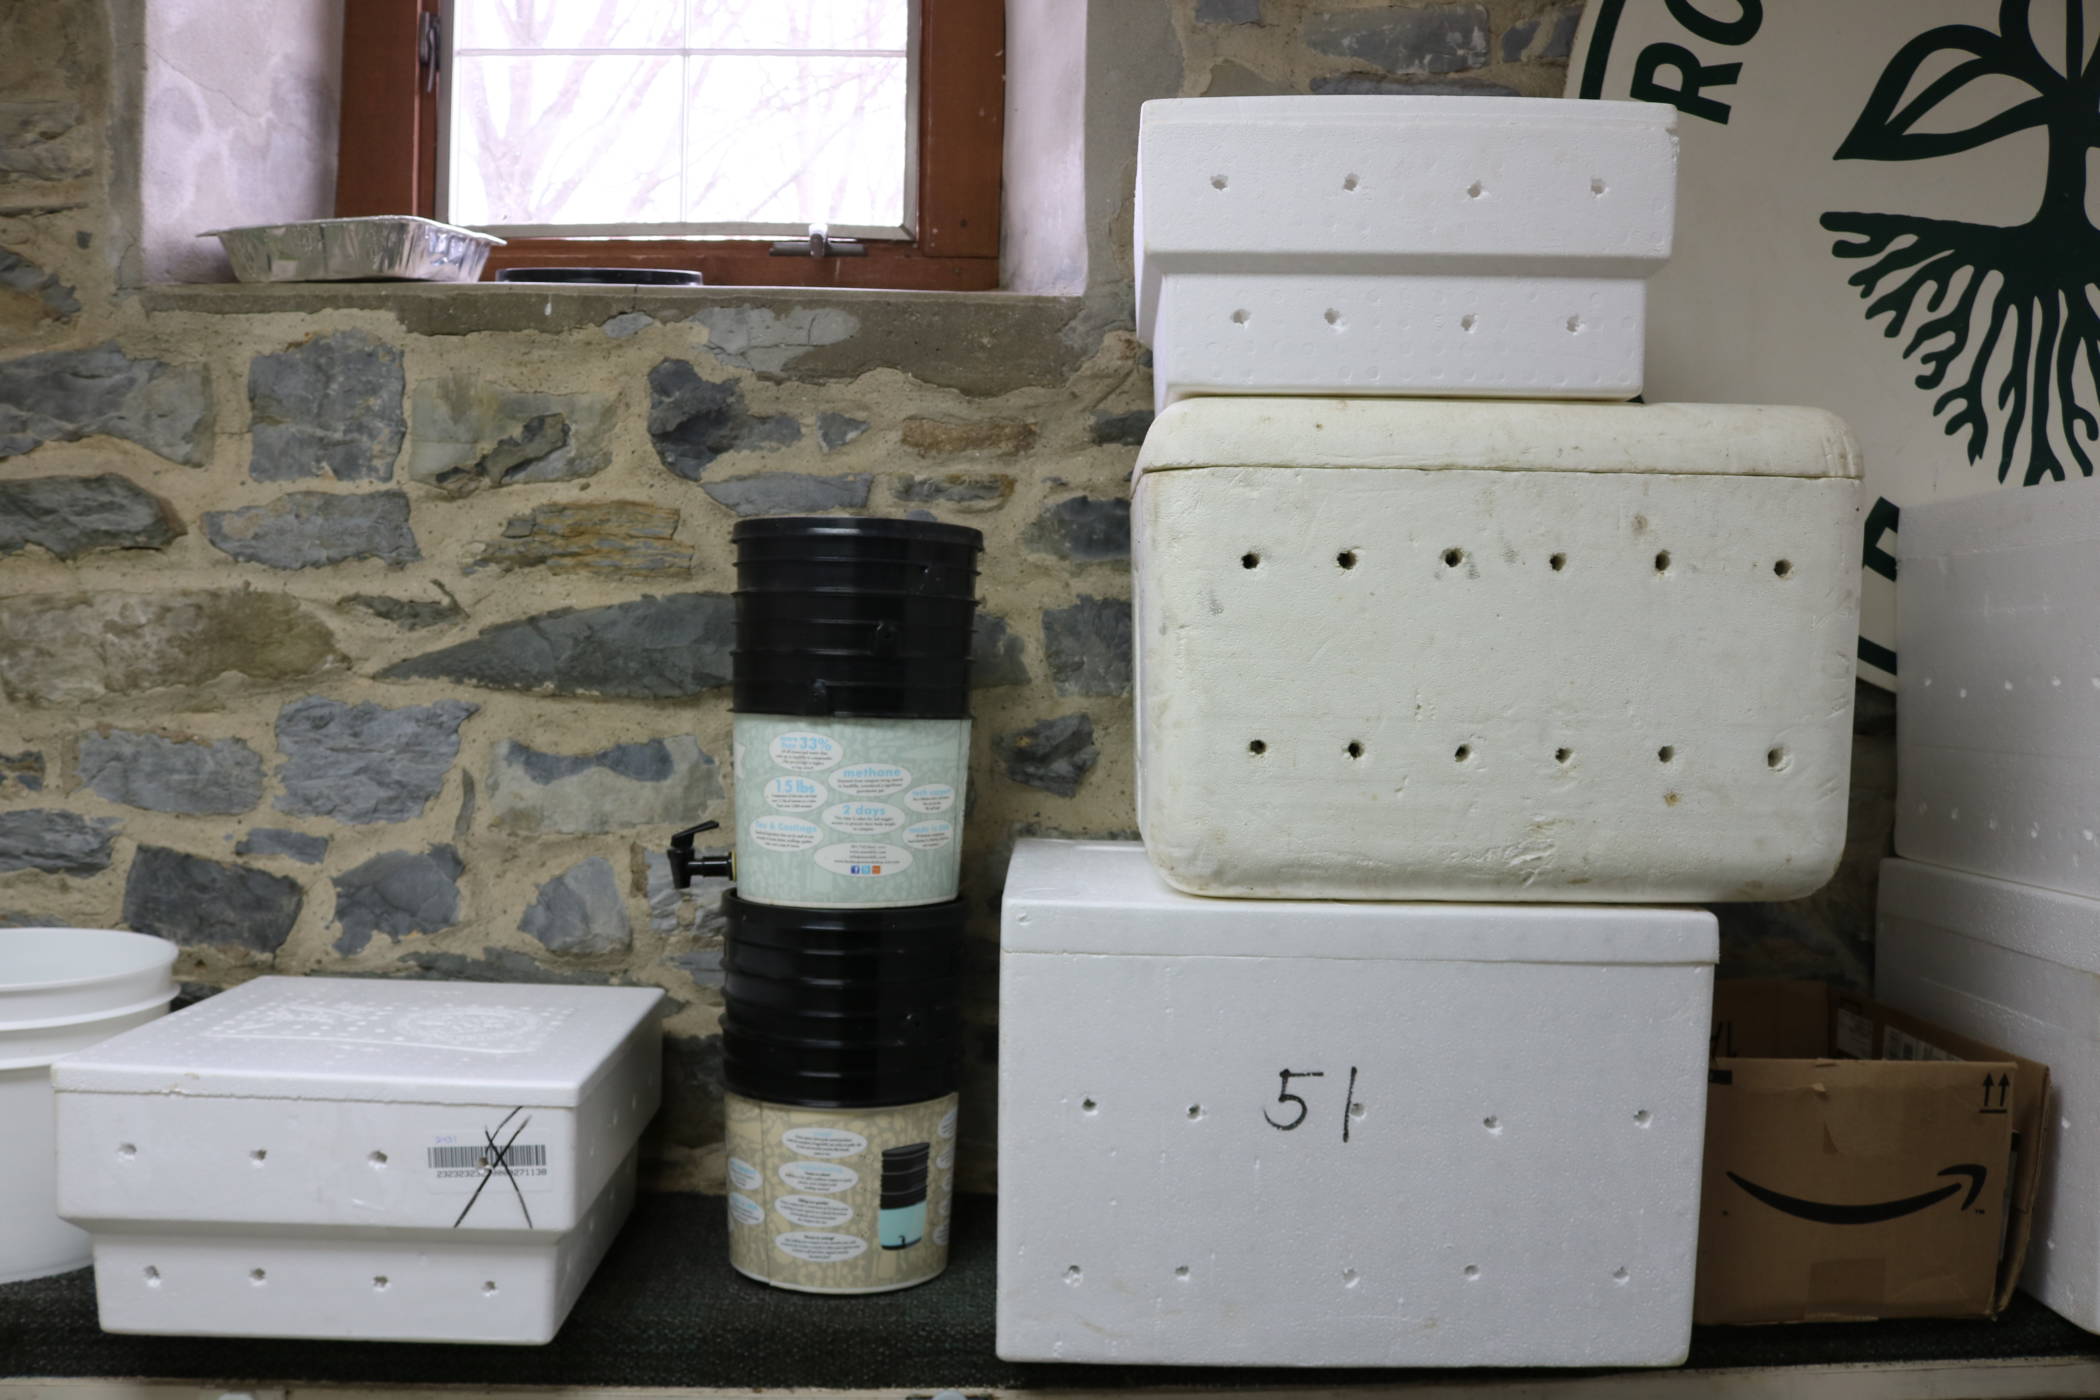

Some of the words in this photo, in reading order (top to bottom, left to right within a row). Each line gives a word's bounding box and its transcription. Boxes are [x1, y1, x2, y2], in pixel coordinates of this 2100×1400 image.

[843, 767, 902, 778] methane
[775, 779, 793, 793] 15
[796, 780, 816, 793] lbs
[842, 805, 852, 815] 2
[856, 804, 886, 817] days
